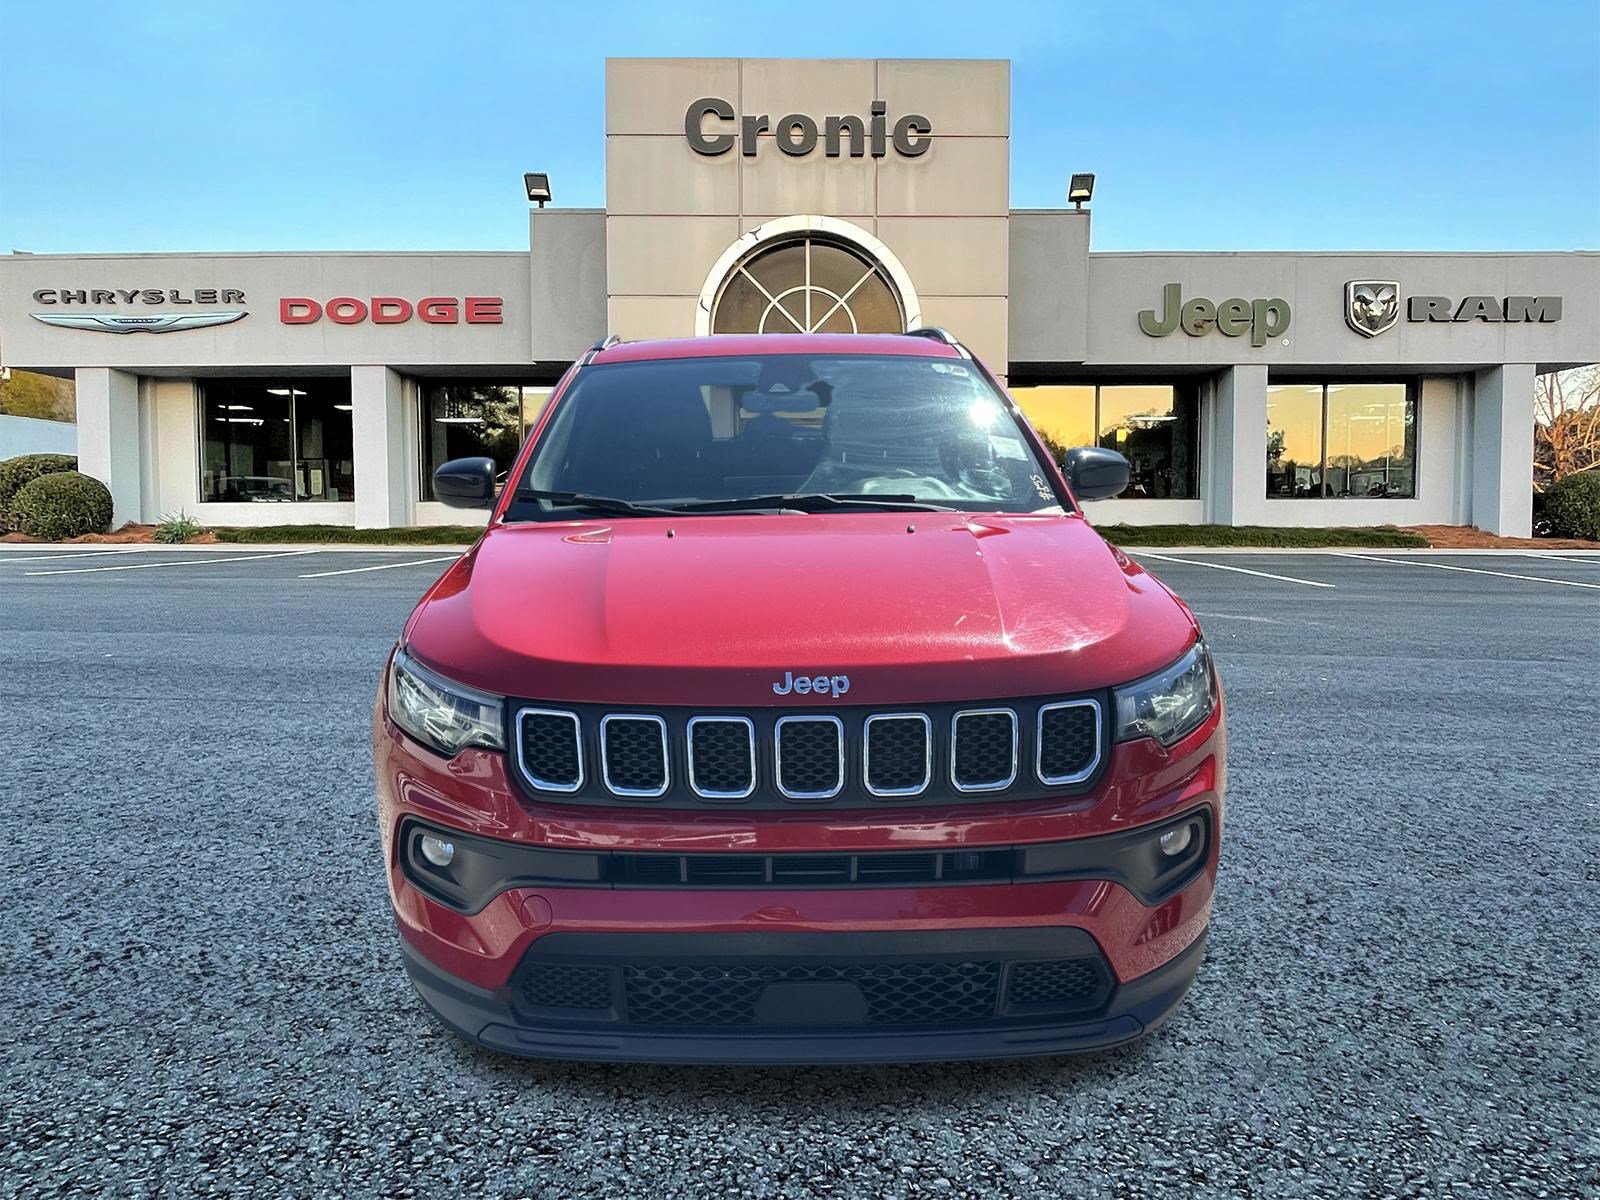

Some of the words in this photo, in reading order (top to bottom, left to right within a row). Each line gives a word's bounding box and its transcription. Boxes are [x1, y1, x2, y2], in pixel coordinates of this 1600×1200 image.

[685, 97, 932, 157] Cronic
[32, 289, 247, 305] CHRYSLER
[280, 297, 503, 324] DODGE
[1407, 296, 1563, 322] RAM
[1138, 283, 1291, 347] Jeep
[772, 671, 850, 698] Jeep
